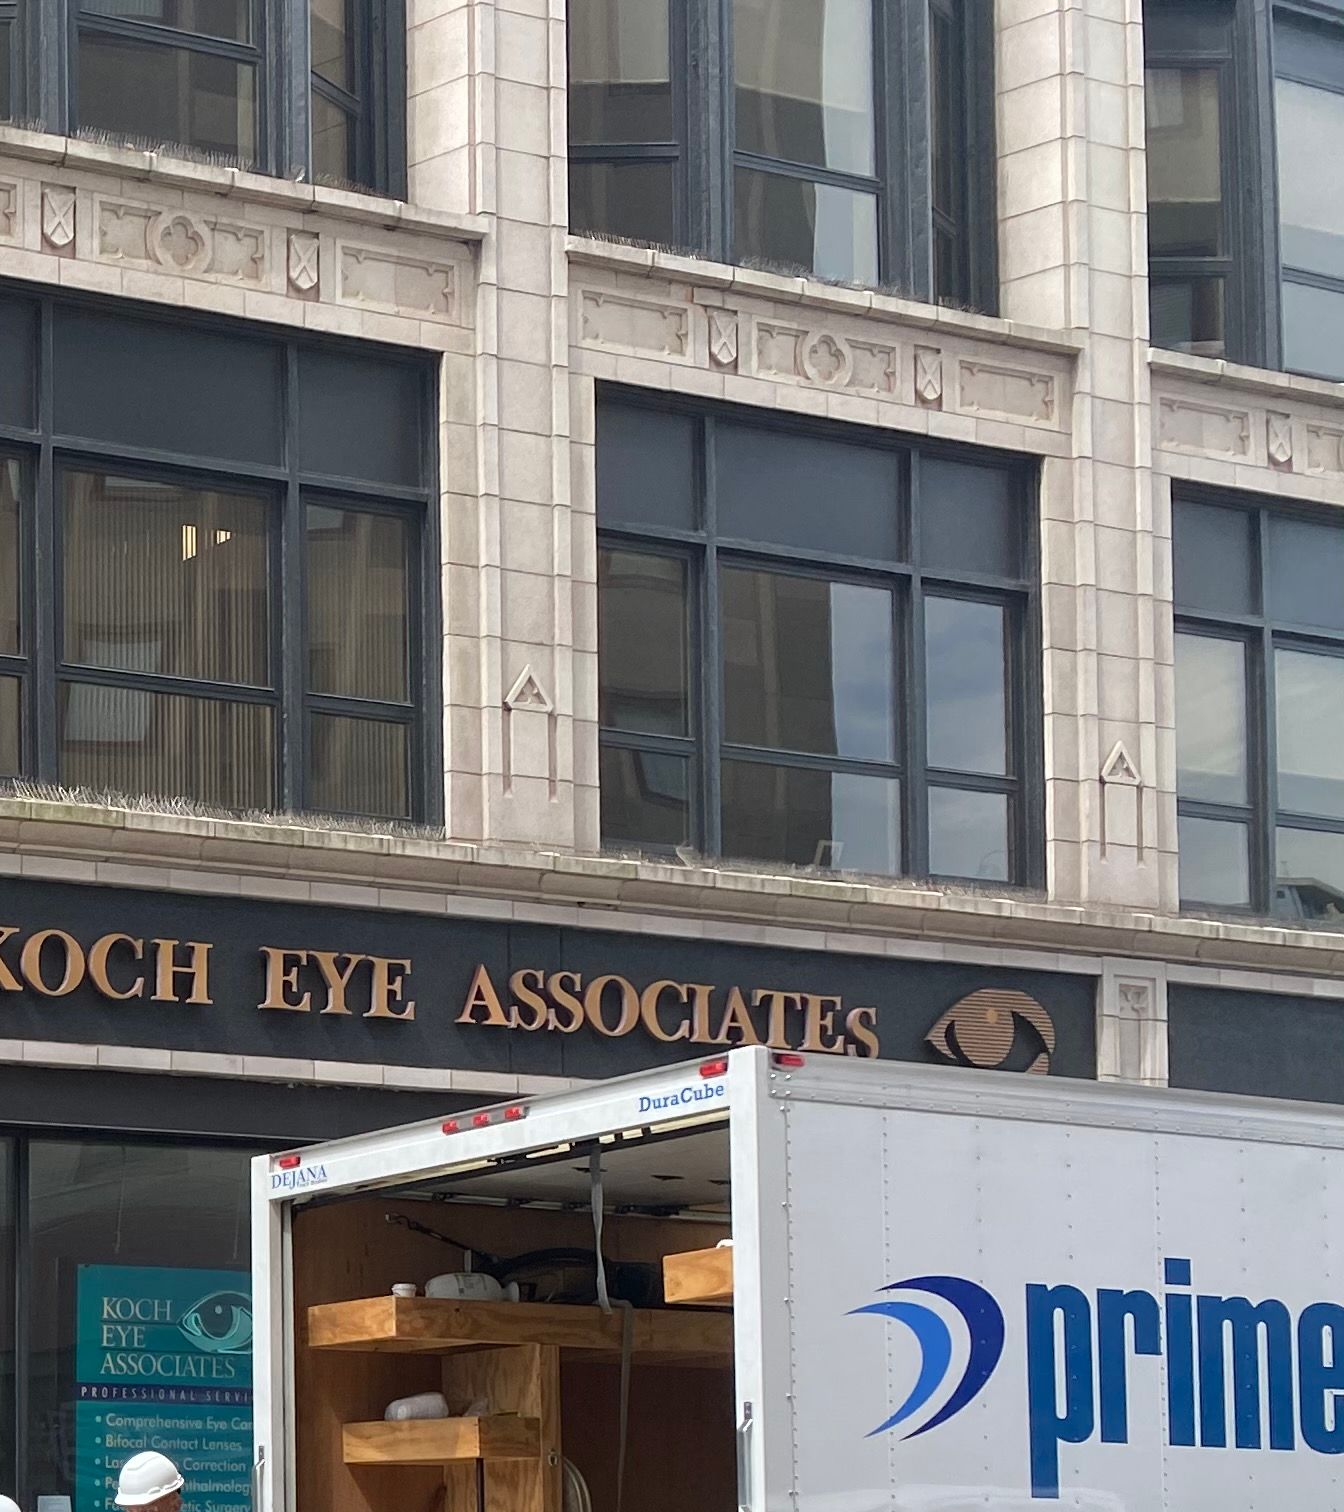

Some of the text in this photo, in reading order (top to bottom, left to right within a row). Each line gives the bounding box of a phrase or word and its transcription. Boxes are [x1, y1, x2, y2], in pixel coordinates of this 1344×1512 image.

[258, 944, 416, 1022] EYE
[454, 962, 879, 1060] ASSOCIATES
[638, 1083, 725, 1112] DuraCube
[271, 1164, 327, 1190] DEJANA
[101, 1296, 171, 1321] KOCH
[101, 1325, 146, 1348] EYE
[100, 1353, 236, 1379] ASSOCIATES
[1024, 1257, 1344, 1499] prime
[81, 1386, 195, 1401] PROFESSIONAL
[105, 1412, 203, 1430] Comprehensive
[206, 1416, 228, 1432] Eye
[105, 1434, 242, 1451] Bifocal Contact Lenses
[183, 1457, 247, 1472] Correction
